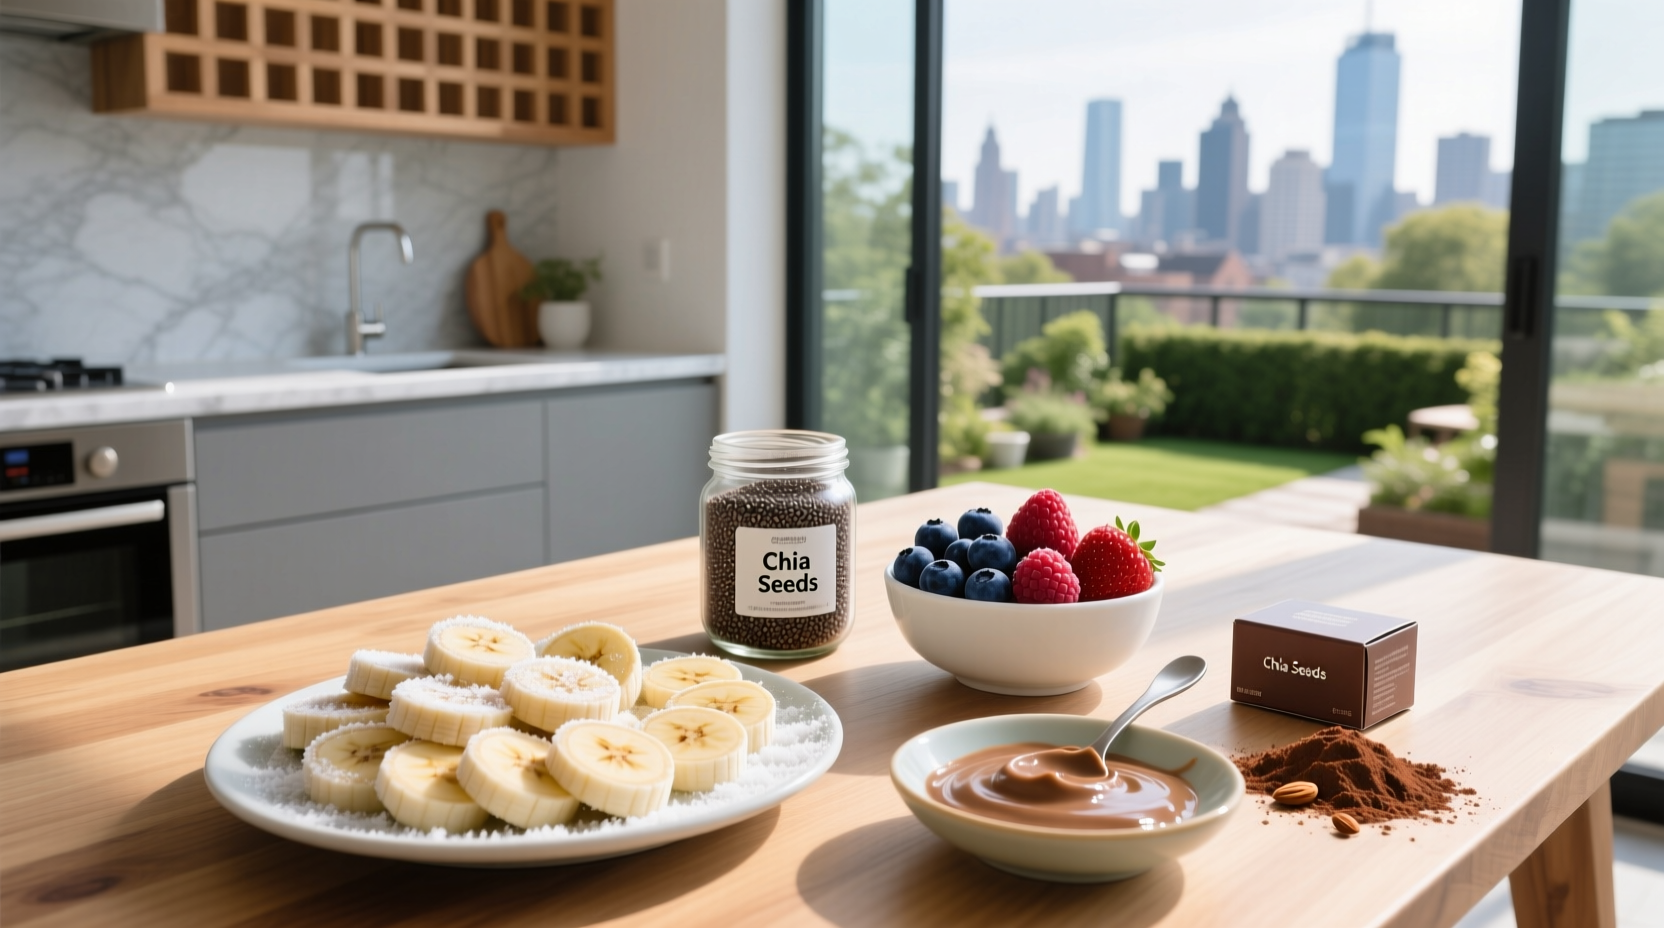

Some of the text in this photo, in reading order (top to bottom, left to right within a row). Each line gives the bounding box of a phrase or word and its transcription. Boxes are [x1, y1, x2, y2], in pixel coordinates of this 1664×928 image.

[763, 551, 810, 571] Chia
[758, 573, 818, 593] Seeds
[1263, 656, 1289, 673] Chia
